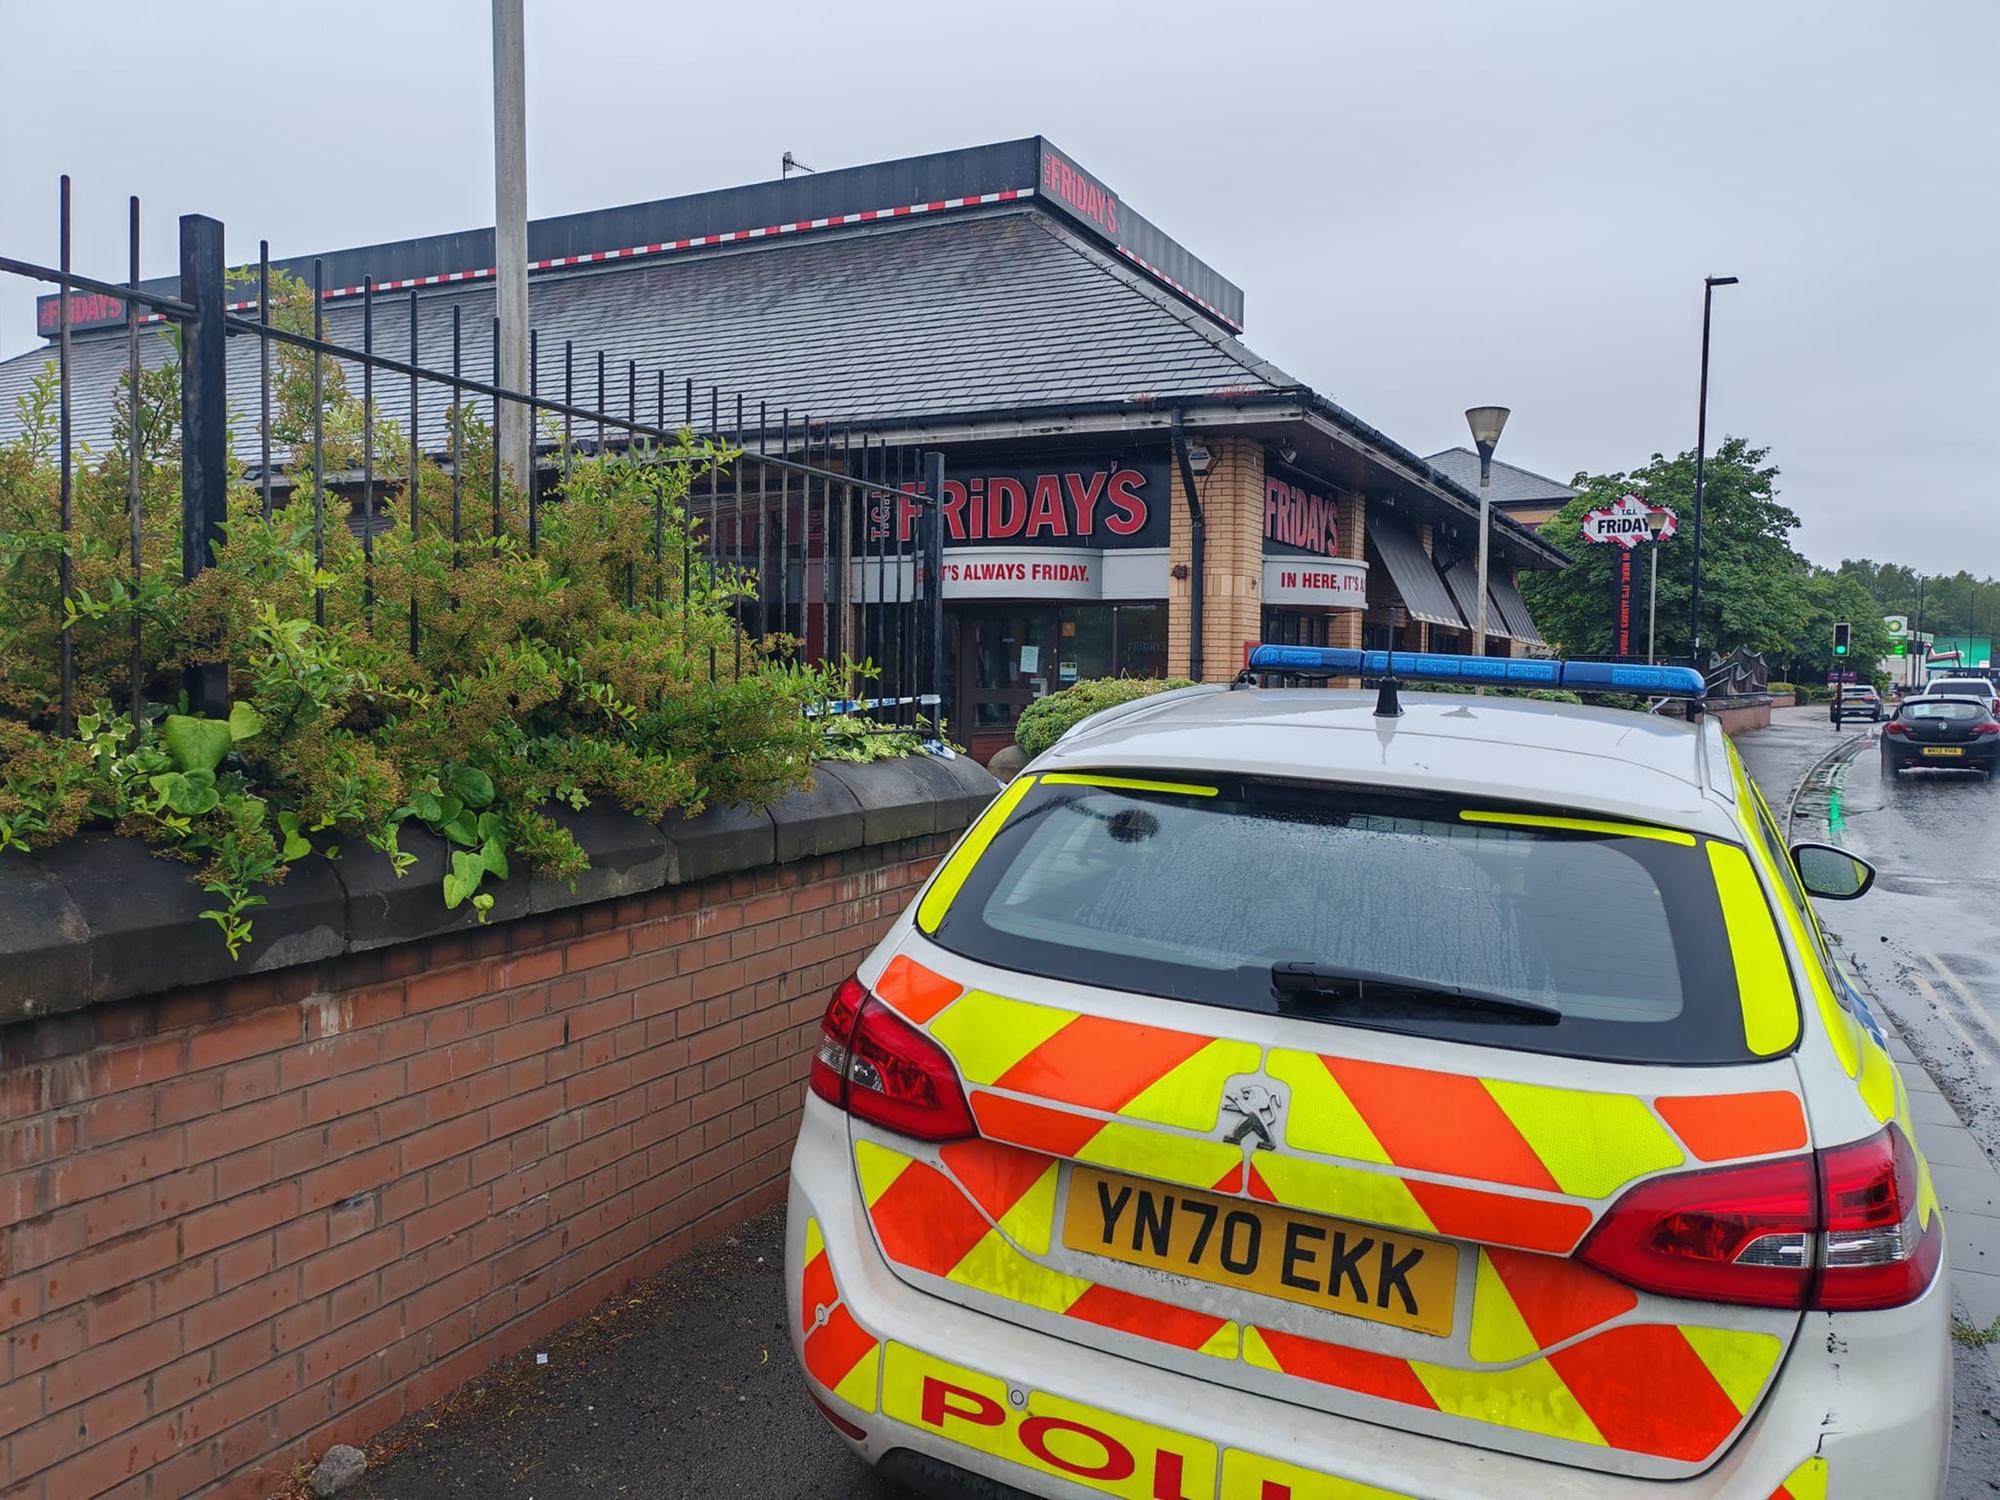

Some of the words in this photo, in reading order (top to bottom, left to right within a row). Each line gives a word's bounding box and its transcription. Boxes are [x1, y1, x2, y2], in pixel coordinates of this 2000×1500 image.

[963, 563, 1025, 581] ALWAYS
[1032, 564, 1089, 583] FRIDAY.
[1281, 572, 1297, 588] IN
[1302, 573, 1341, 593] HERE,
[1343, 575, 1360, 592] IT'S
[1097, 1180, 1262, 1277] YN70
[1281, 1221, 1424, 1317] EKK
